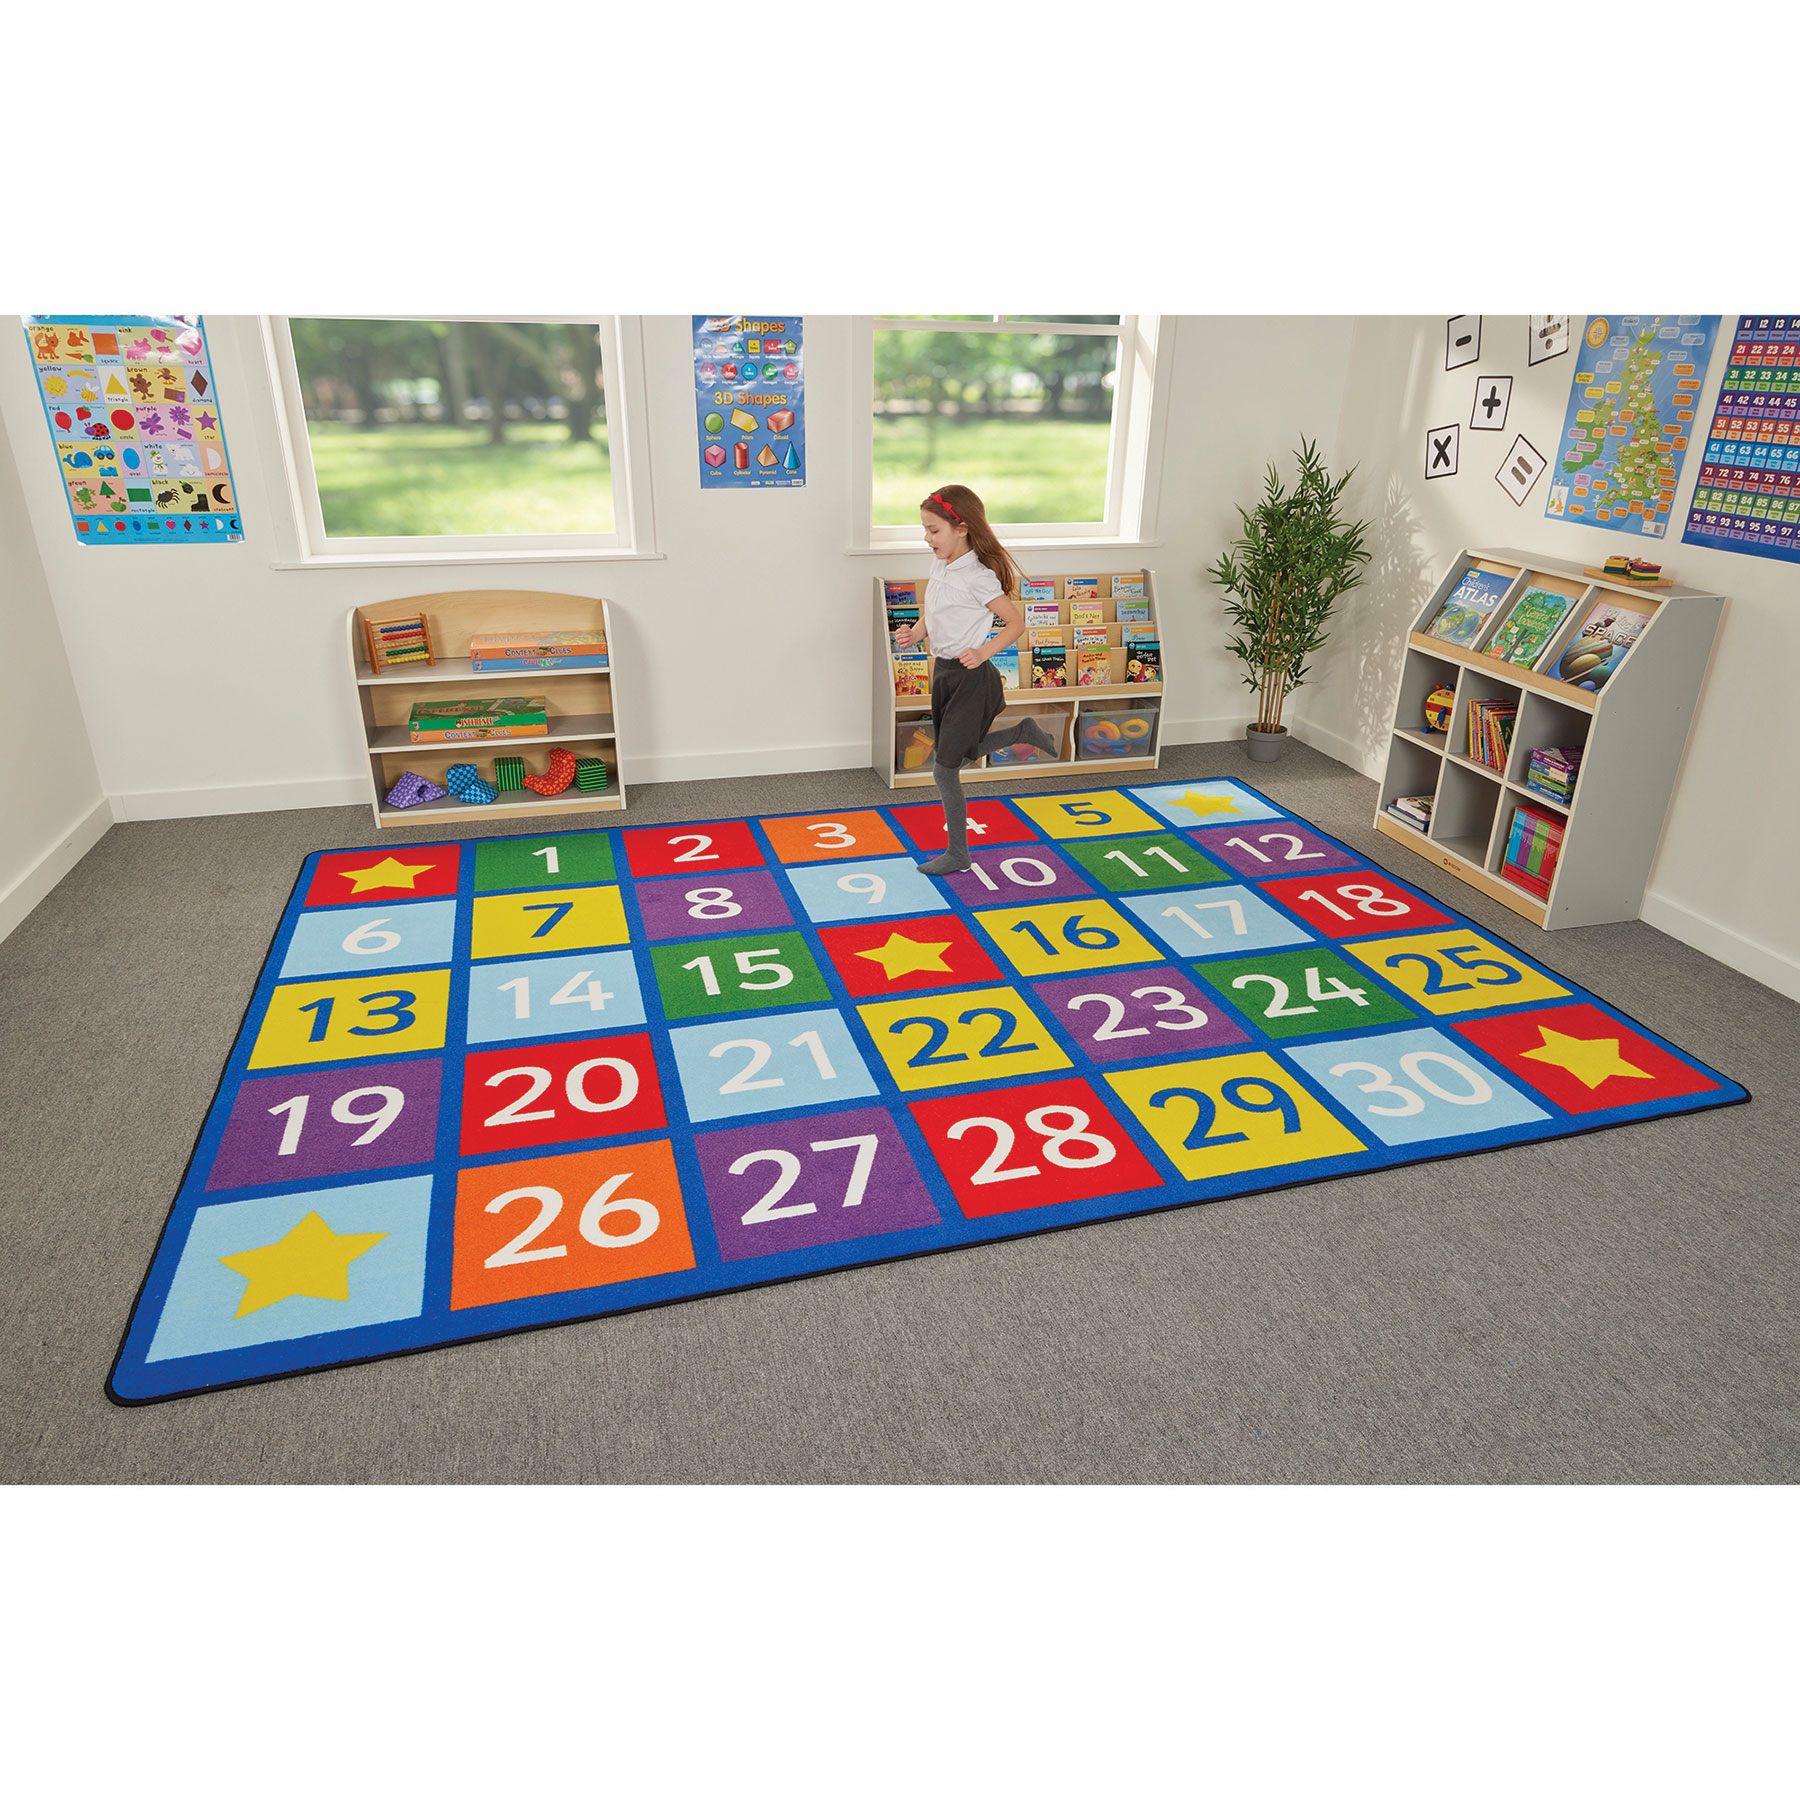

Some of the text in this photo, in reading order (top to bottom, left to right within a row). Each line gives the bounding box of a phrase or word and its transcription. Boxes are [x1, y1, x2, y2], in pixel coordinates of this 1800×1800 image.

[734, 317, 785, 336] Shapes
[1744, 319, 1752, 329] 11
[1759, 319, 1769, 329] 12
[1775, 319, 1785, 329] 13
[1736, 345, 1795, 355] 21 22 23 24
[1730, 370, 1739, 379] 31
[1744, 370, 1756, 379] 32
[1760, 371, 1772, 380] 33
[1776, 371, 1788, 381] 34
[714, 390, 787, 408] 3D Shapes
[1723, 395, 1797, 408] 41 42 43 44 45
[1717, 420, 1726, 428] 51
[1731, 420, 1743, 429] 52
[1746, 421, 1758, 430] 53
[1761, 422, 1774, 431] 54
[1778, 423, 1790, 433] 55
[1710, 443, 1799, 460] 61 62 63 64 65 66
[1704, 467, 1791, 485] 71 72 73 74 75 76
[1698, 490, 1800, 511] 81 82 83 84 85 86 87
[1693, 513, 1702, 522] 91
[1705, 515, 1717, 524] 92
[1720, 517, 1731, 527] 93
[1734, 520, 1745, 529] 94
[1749, 522, 1761, 532] 95
[1765, 524, 1776, 534] 96
[1781, 527, 1793, 536] 97
[1453, 586, 1498, 607] ATLAS
[1582, 624, 1639, 649] SPACE
[461, 717, 493, 727] INFERENCE
[1059, 802, 1112, 826] 5
[666, 835, 720, 863] 2
[806, 823, 856, 849] 3
[1224, 834, 1326, 864] 12
[532, 847, 560, 873] 1
[960, 857, 1057, 891] 10
[1103, 847, 1189, 877] 11
[684, 887, 742, 919] 8
[837, 873, 886, 904] 9
[1298, 884, 1411, 921] 18
[522, 902, 574, 938] 7
[1011, 915, 1121, 956] 16
[1161, 900, 1248, 939] 17
[341, 919, 401, 955] 6
[682, 948, 793, 996] 15
[1385, 945, 1523, 996] 25
[497, 971, 614, 1020] 14
[1231, 967, 1370, 1019] 24
[298, 990, 417, 1043] 13
[1066, 985, 1209, 1042] 23
[888, 1006, 1040, 1069] 22
[708, 1030, 837, 1095] 21
[483, 1057, 639, 1127] 20
[1328, 1050, 1493, 1118] 30
[267, 1086, 405, 1156] 19
[1148, 1076, 1302, 1151] 29
[946, 1104, 1117, 1187] 28
[727, 1134, 879, 1227] 27
[483, 1172, 660, 1270] 26
